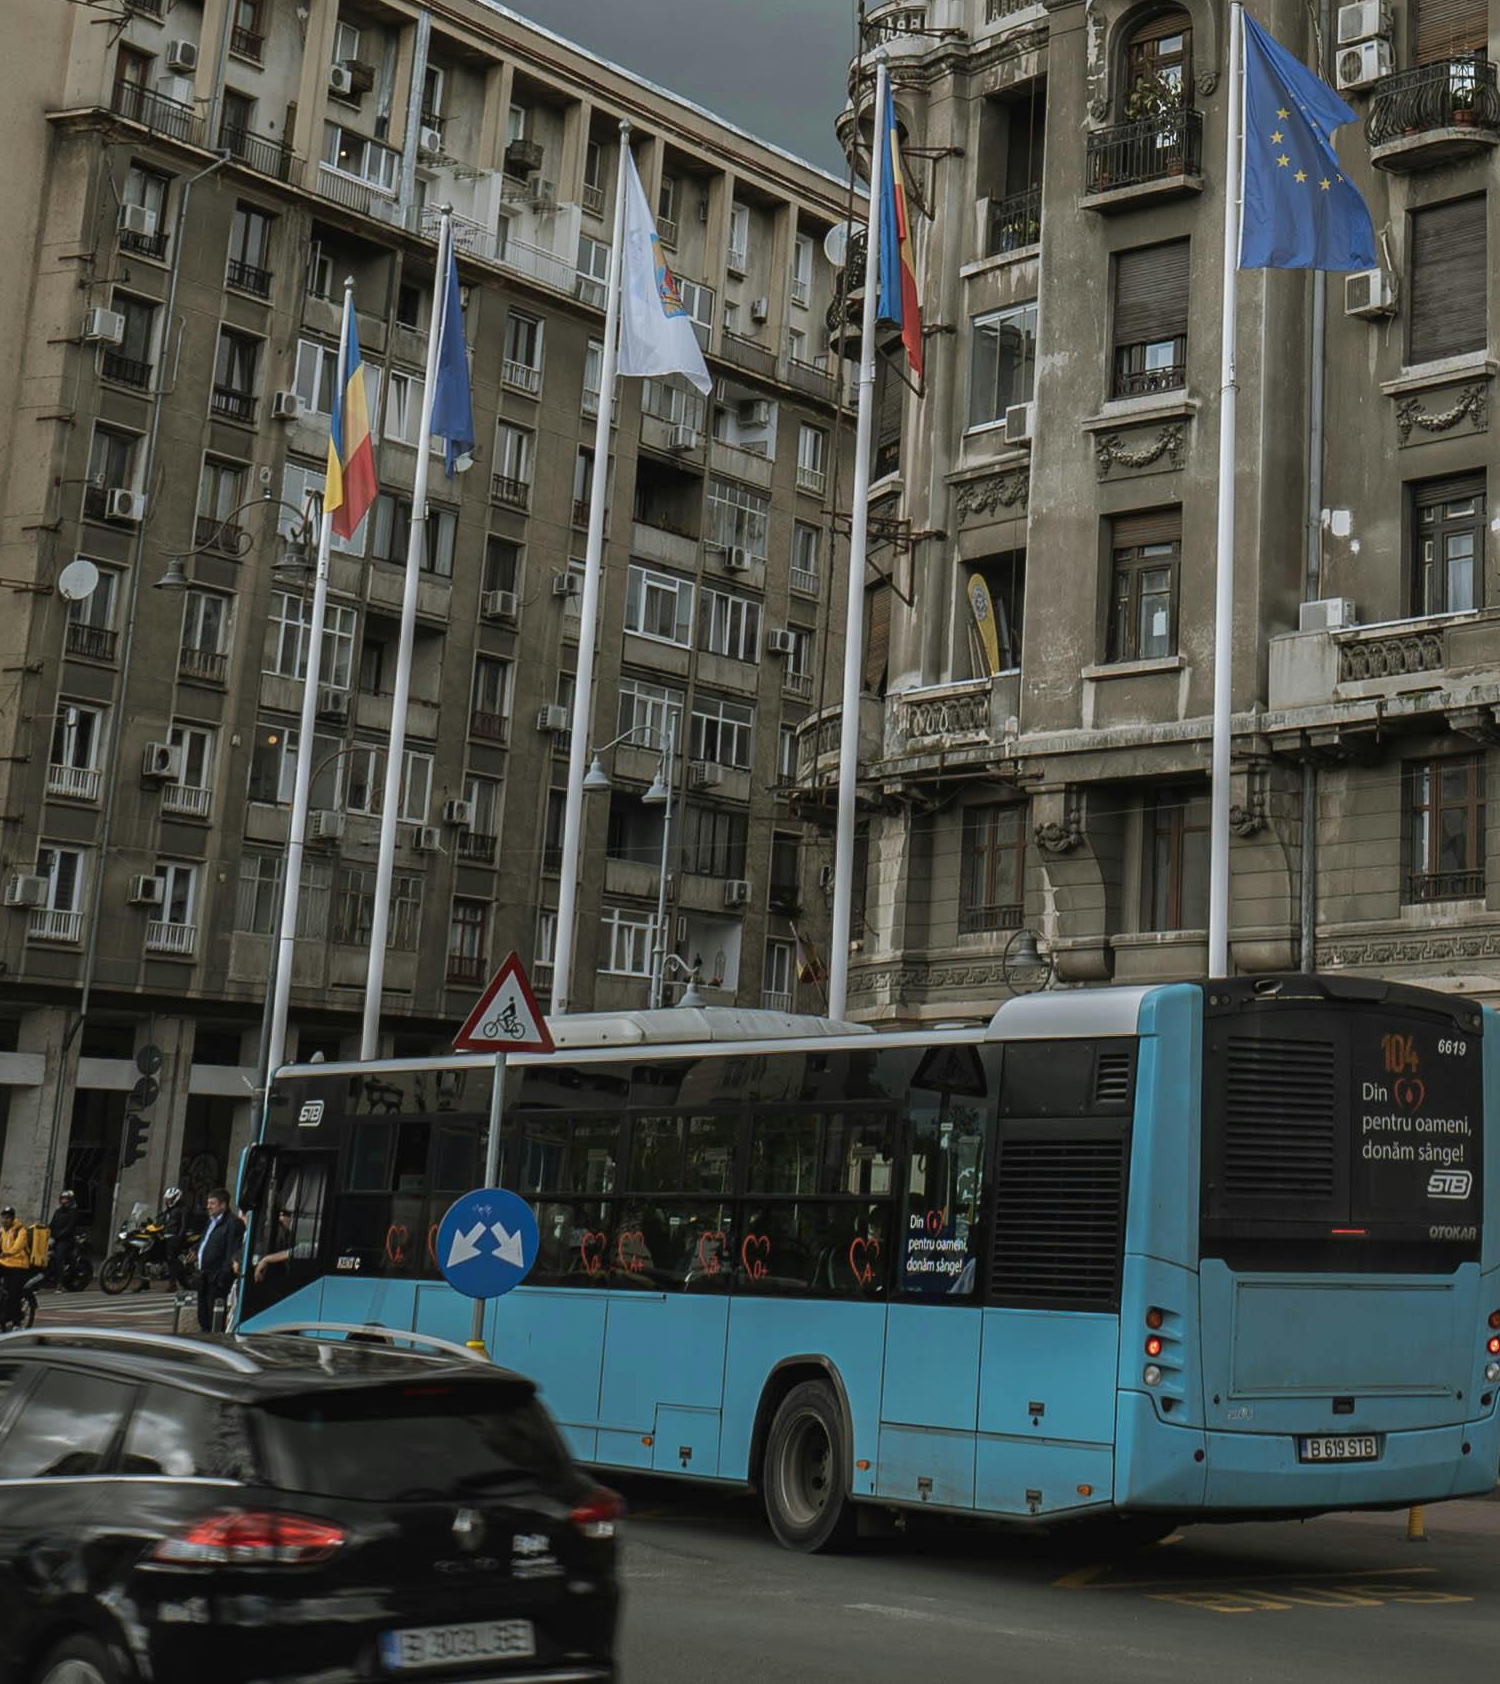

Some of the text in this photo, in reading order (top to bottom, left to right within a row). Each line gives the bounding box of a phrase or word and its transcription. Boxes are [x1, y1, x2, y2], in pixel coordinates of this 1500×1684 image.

[1381, 1035, 1419, 1073] 104
[1438, 1039, 1466, 1056] 6619
[1362, 1082, 1388, 1101] Din
[1362, 1115, 1472, 1136] pentru oameni,
[1362, 1140, 1464, 1166] donăm sânge!
[910, 1214, 924, 1229] Din
[1430, 1225, 1476, 1240] OTOKAR
[908, 1238, 935, 1253] pentru
[1311, 1438, 1374, 1457] B 619 STB
